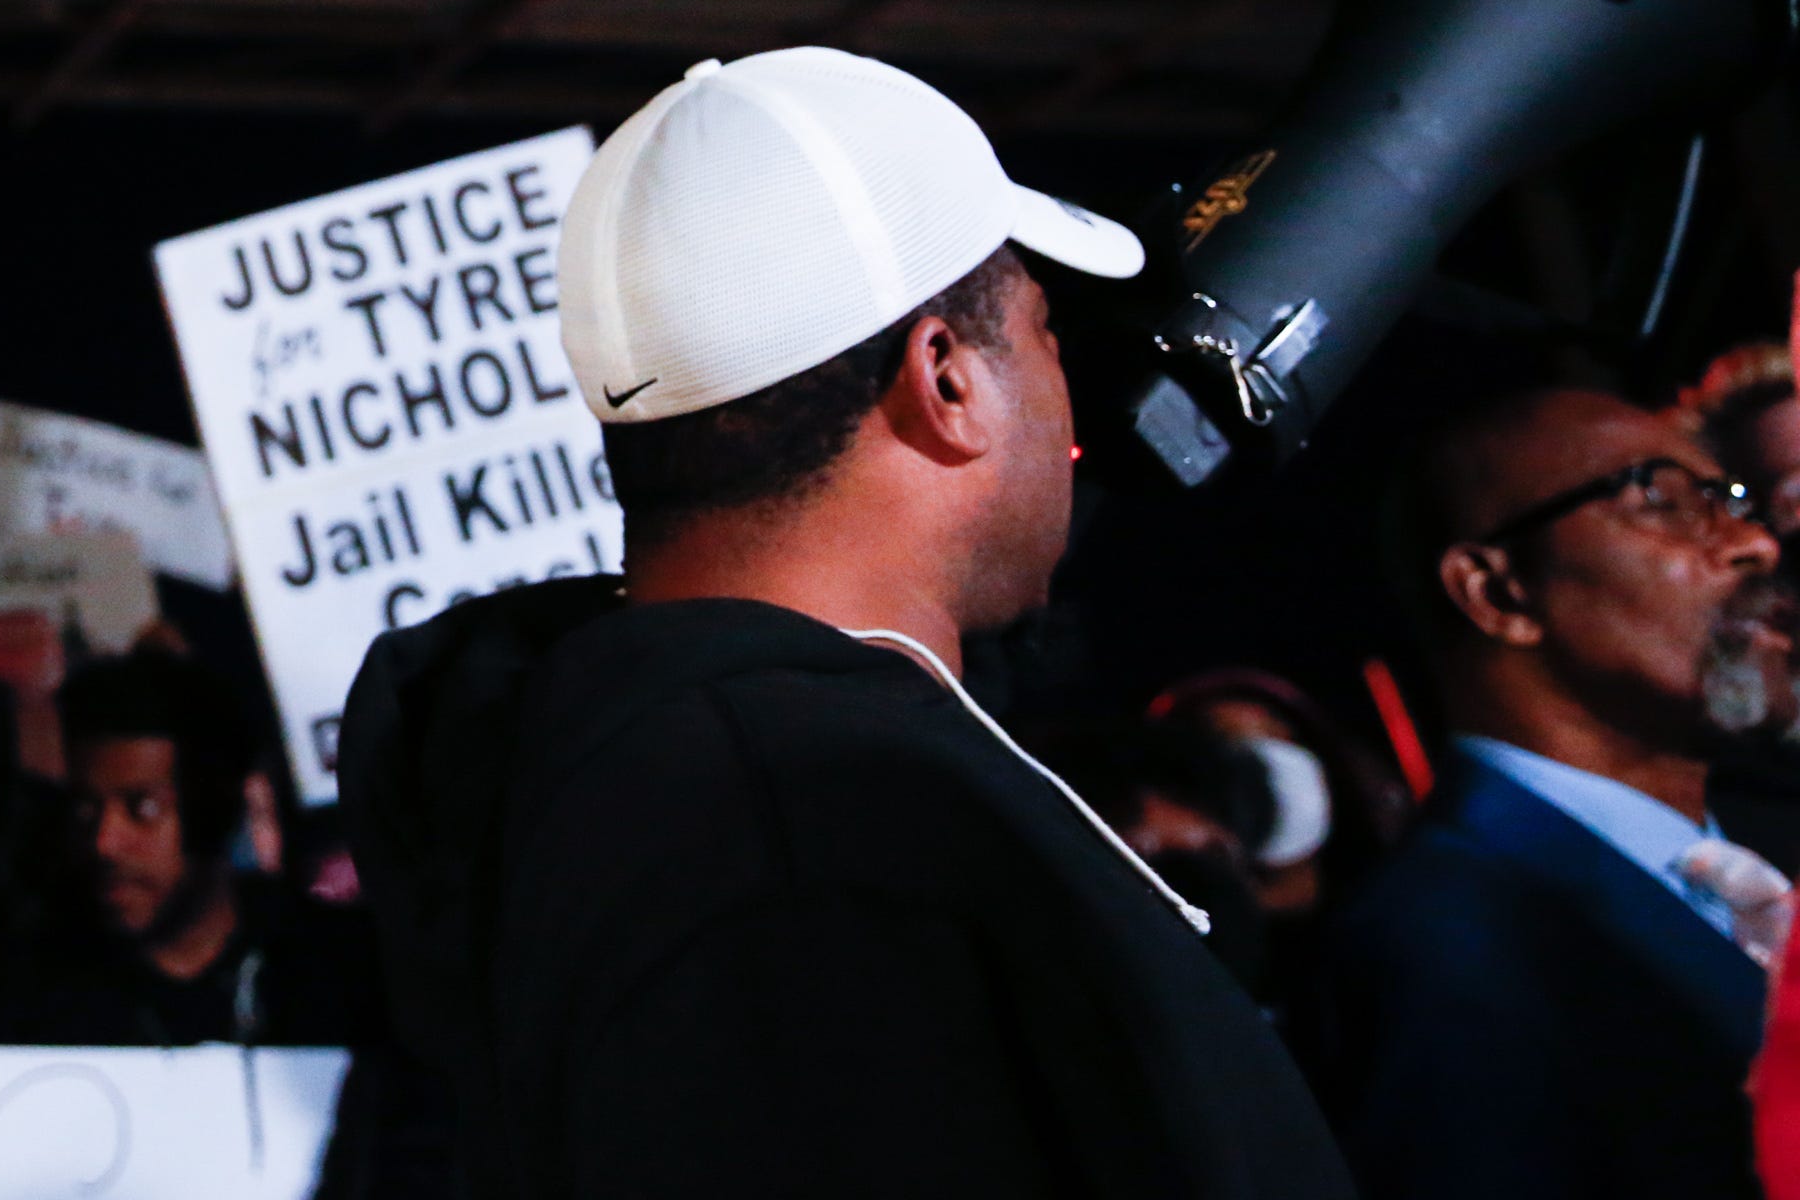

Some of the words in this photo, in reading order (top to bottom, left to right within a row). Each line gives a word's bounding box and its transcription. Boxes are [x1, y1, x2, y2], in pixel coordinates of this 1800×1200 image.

[220, 164, 560, 313] JUSTICE
[343, 245, 560, 360] TYRE
[248, 337, 572, 479] NICHOL
[280, 485, 423, 590] Jail
[442, 439, 618, 544] Kille
